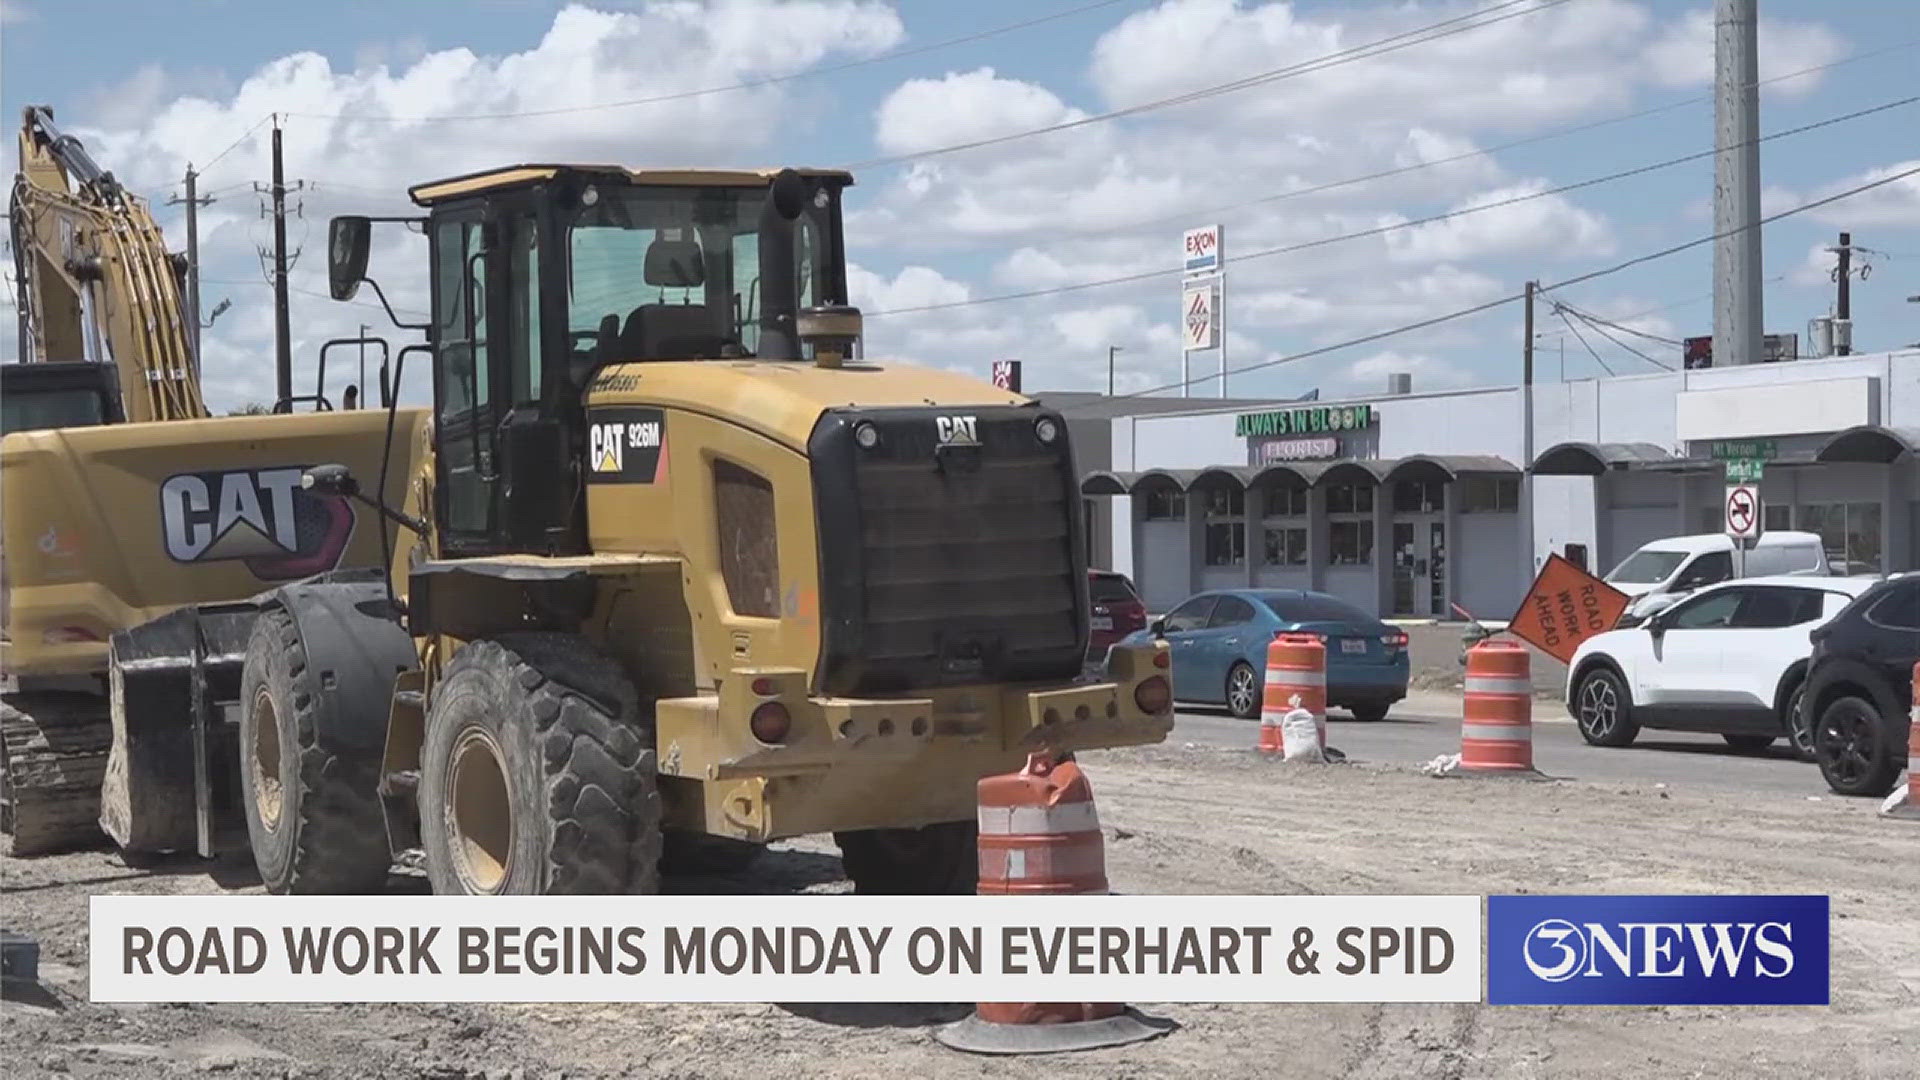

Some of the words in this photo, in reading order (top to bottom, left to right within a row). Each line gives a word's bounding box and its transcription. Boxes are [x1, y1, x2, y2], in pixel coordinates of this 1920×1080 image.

[1186, 230, 1216, 256] EXXON
[936, 416, 977, 443] CAT
[1235, 411, 1287, 436] ALWAYS
[1290, 409, 1308, 433] IN
[1311, 405, 1368, 432] BLOOM
[590, 423, 624, 472] CAT
[628, 422, 660, 448] 926M
[1266, 441, 1330, 458] FLORIST
[163, 469, 302, 560] CAT
[1533, 594, 1560, 647] AHEAD
[1558, 589, 1582, 638] WORK
[1580, 583, 1603, 630] ROAD
